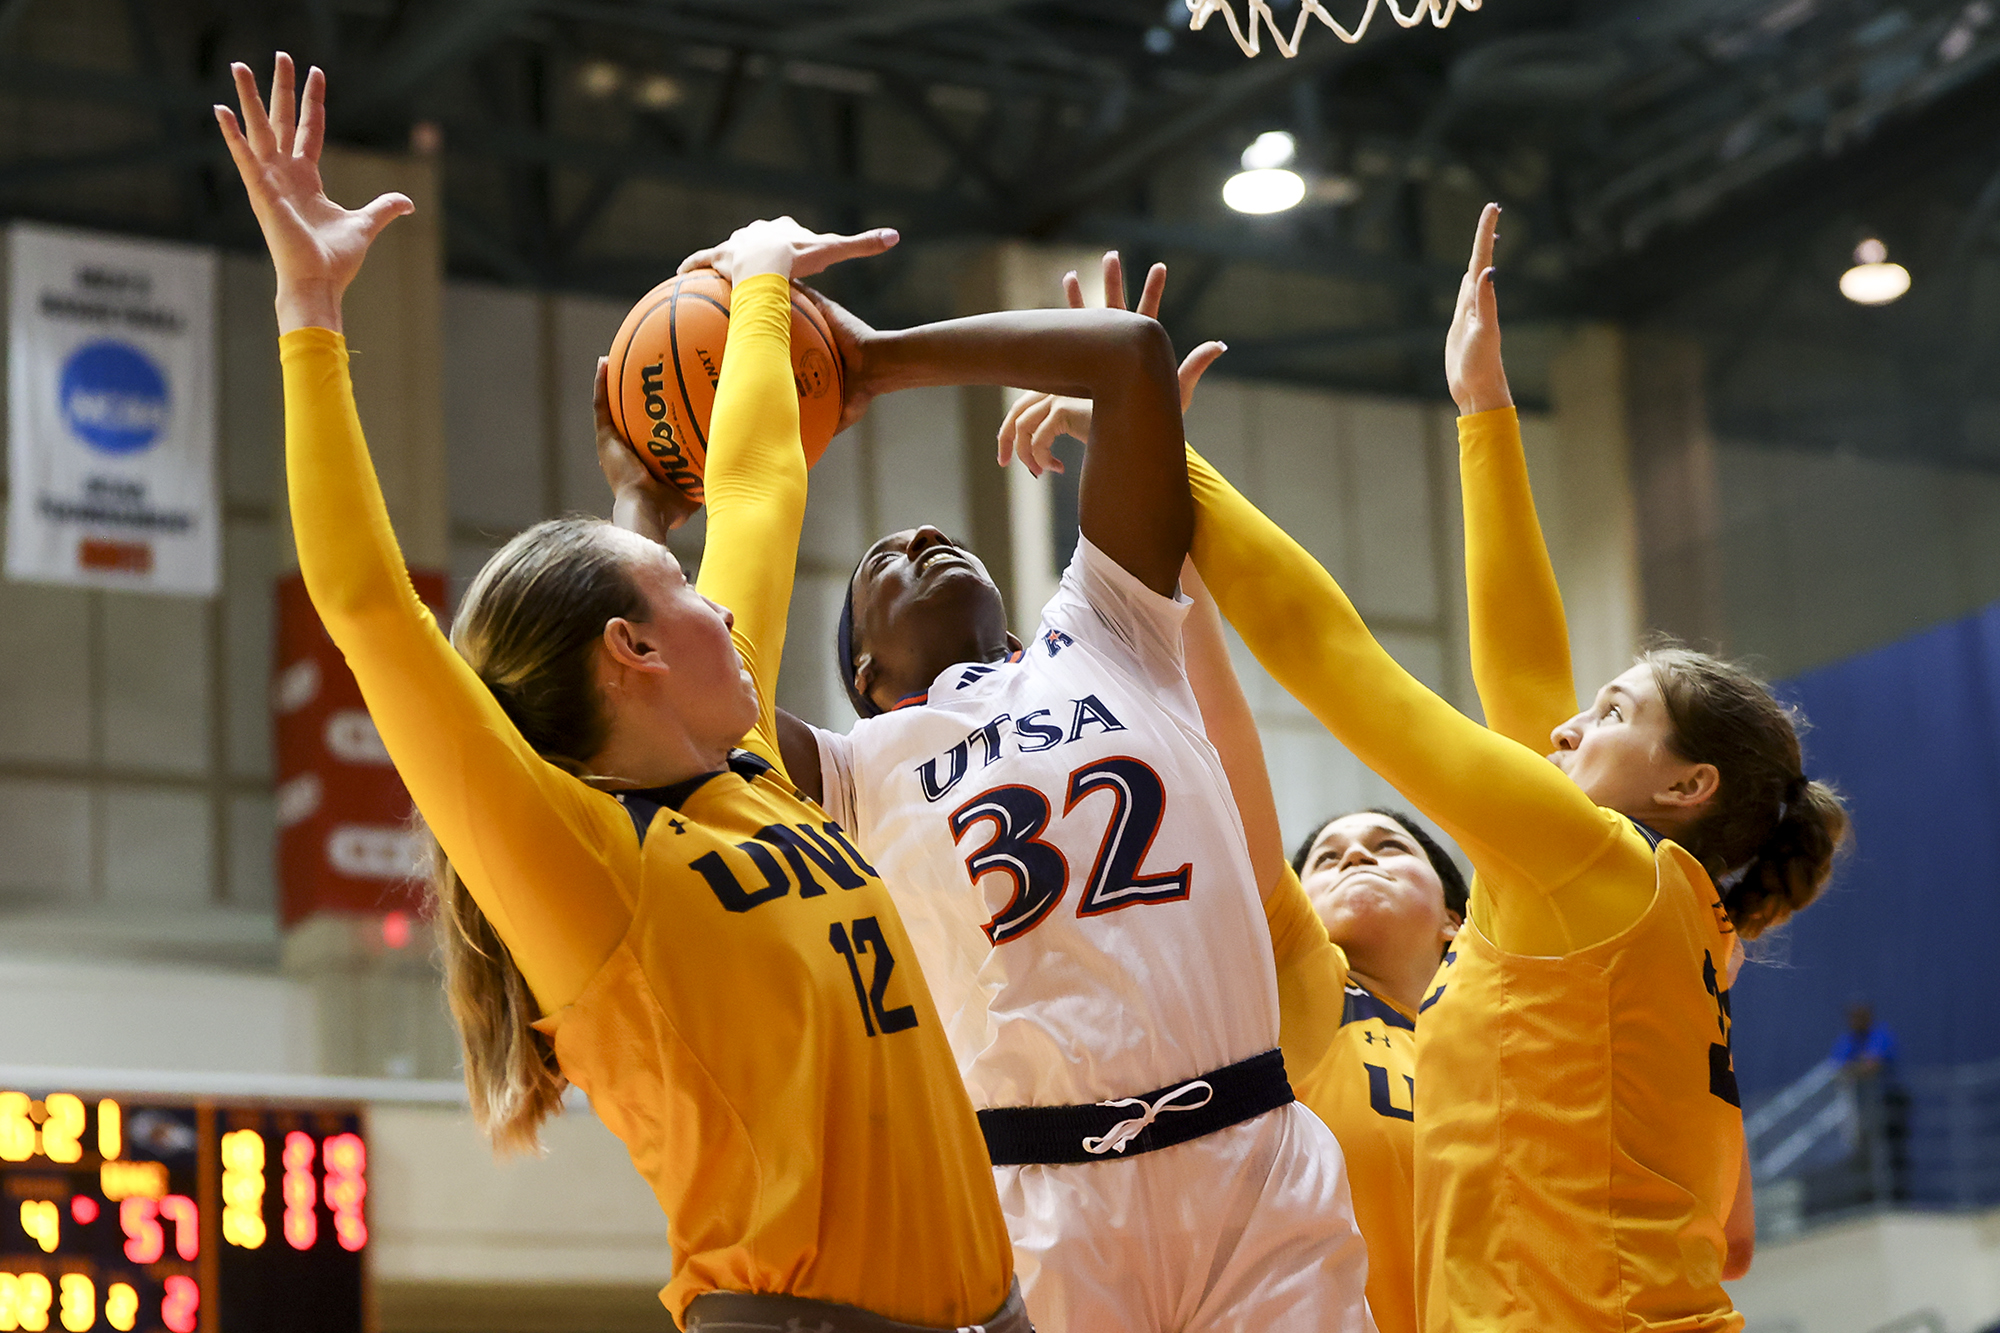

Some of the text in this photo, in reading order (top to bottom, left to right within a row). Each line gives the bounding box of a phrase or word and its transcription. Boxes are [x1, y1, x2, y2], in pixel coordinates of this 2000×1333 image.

[914, 694, 1128, 802] UTSA
[948, 755, 1193, 948] 32
[829, 916, 919, 1037] 12
[120, 1195, 200, 1264] 57
